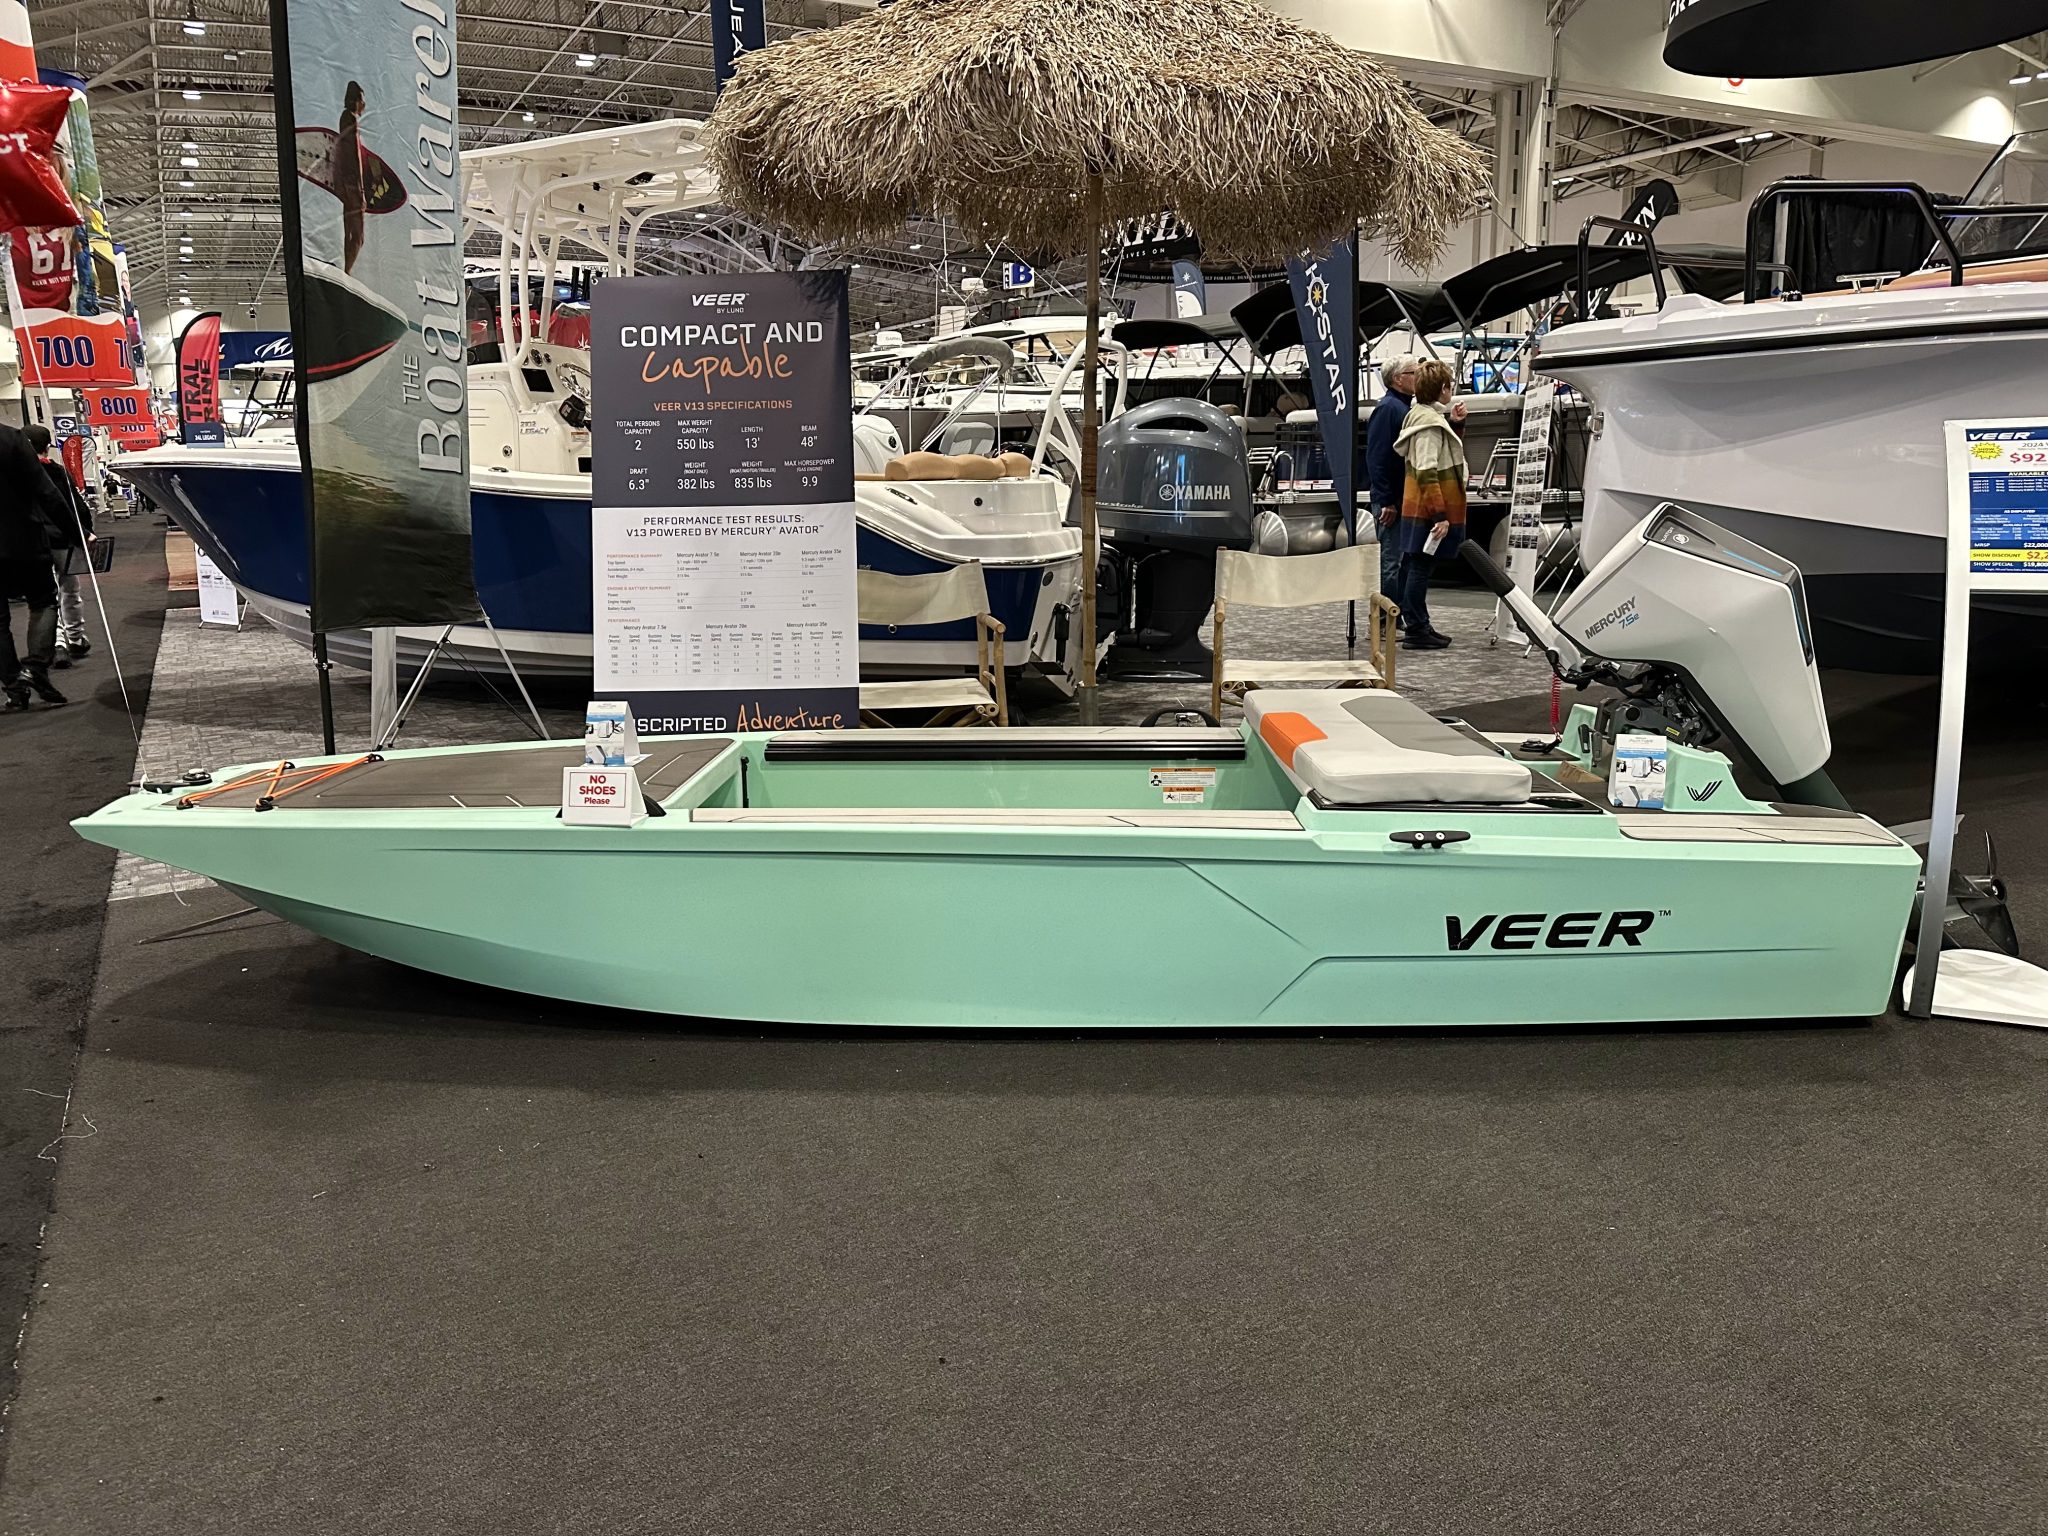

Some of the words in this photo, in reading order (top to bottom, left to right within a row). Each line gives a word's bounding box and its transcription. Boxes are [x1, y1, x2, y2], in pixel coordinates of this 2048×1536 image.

[1012, 262, 1034, 286] B
[620, 323, 756, 348] COMPACT
[766, 322, 823, 344] AND
[35, 335, 95, 368] 700
[642, 333, 793, 394] Capable
[402, 353, 421, 404] THE
[100, 397, 137, 416] 800
[654, 403, 682, 412] VEER
[684, 402, 704, 410] V13
[706, 400, 793, 410] SPECIFICATIONS
[634, 440, 642, 450] 2
[676, 438, 696, 450] 550
[699, 438, 715, 450] lbs
[745, 437, 760, 449] 13'
[801, 436, 818, 447] 48"
[628, 479, 650, 490] 6.3"
[677, 478, 697, 490] 382
[699, 478, 715, 489] lbs
[734, 477, 754, 488] 835
[756, 477, 772, 488] lbs
[802, 476, 818, 487] 9.9
[1176, 485, 1231, 500] YAMAHA
[643, 516, 723, 525] PERFORMANCE
[726, 516, 752, 524] TEST
[755, 514, 804, 524] RESULTS:
[626, 528, 647, 537] V13
[649, 528, 702, 536] POWERED
[704, 528, 718, 536] BY
[1585, 596, 1636, 639] MERCURY
[1618, 613, 1640, 629] 7.5e
[634, 716, 727, 732] SCRIPTED
[736, 702, 845, 732] Adventure
[590, 775, 606, 784] NO
[579, 786, 616, 795] SHOES
